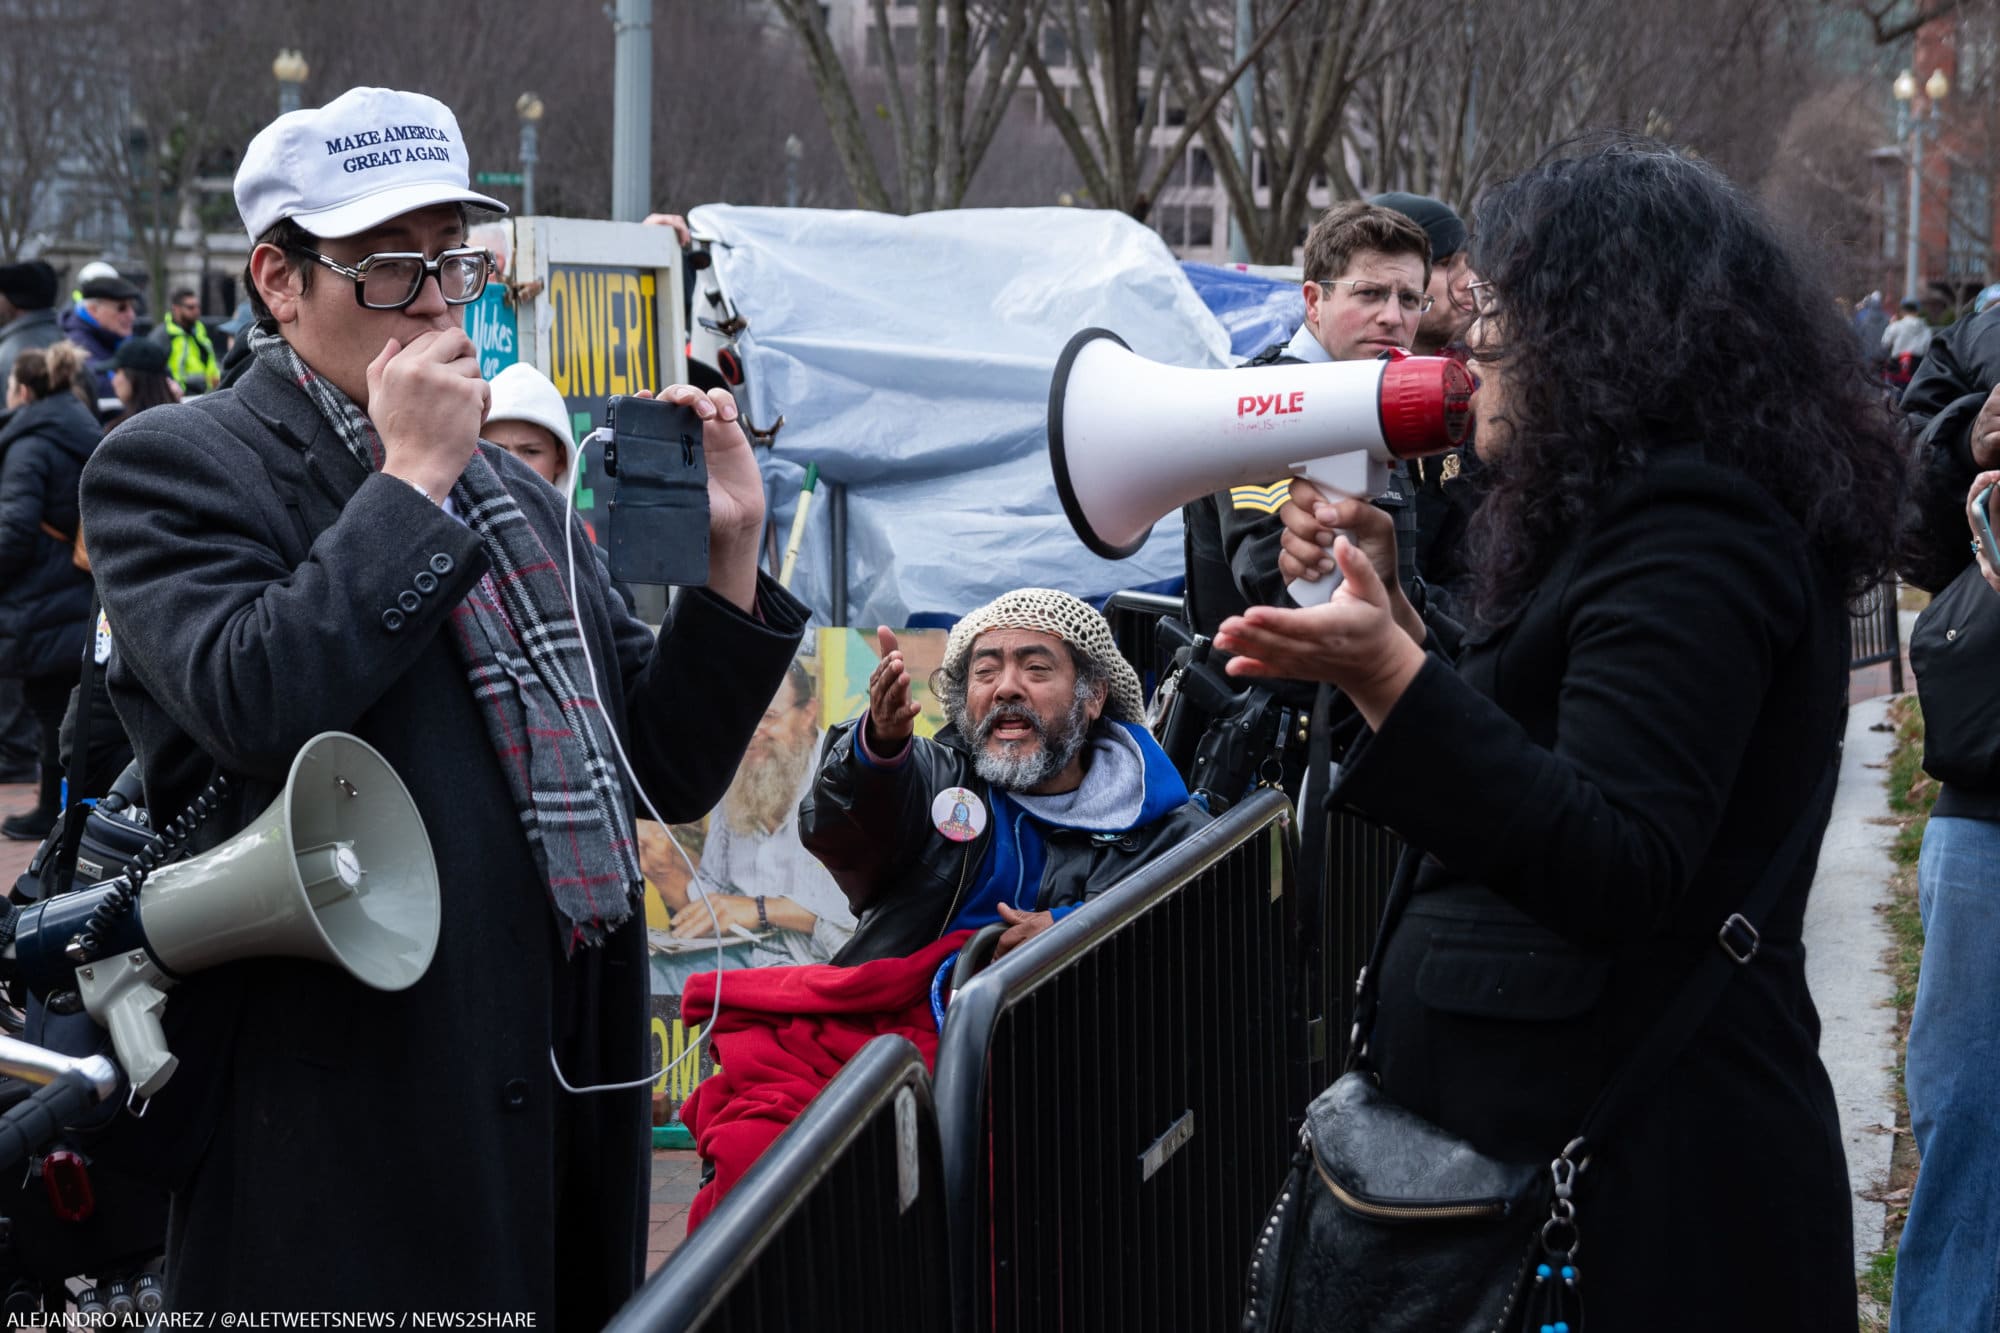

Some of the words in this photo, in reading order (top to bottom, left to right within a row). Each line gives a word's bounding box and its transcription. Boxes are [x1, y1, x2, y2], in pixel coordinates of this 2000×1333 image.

[325, 130, 381, 155] MAKE
[383, 125, 451, 143] AMERICA
[343, 148, 402, 173] GREAT
[405, 146, 450, 162] AGAIN
[473, 300, 513, 365] Nukes
[550, 270, 657, 398] ONVERT
[1237, 391, 1304, 417] PYLE
